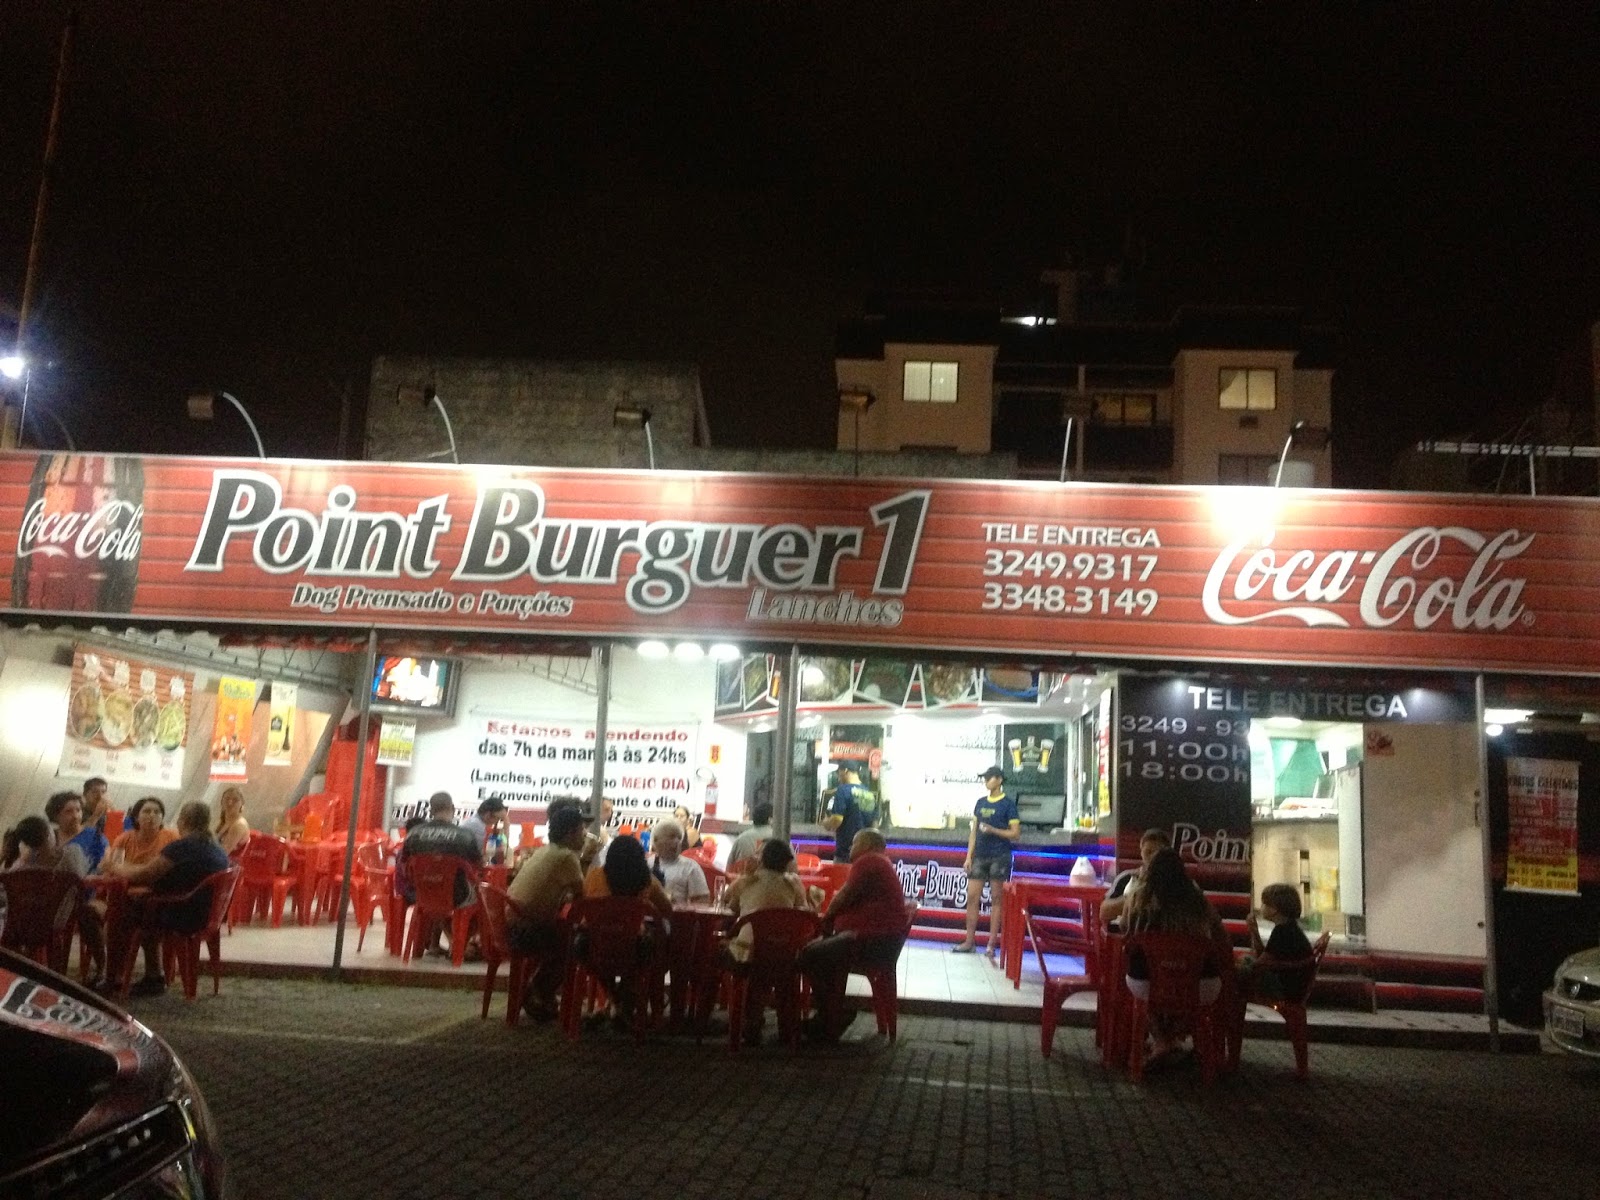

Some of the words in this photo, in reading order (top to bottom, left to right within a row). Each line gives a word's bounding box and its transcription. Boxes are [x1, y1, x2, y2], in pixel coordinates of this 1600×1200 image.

[17, 497, 144, 561] Coca-Cola
[184, 468, 453, 578] Point
[450, 477, 864, 615] Burguer
[869, 488, 933, 597] 1
[981, 522, 1038, 545] TELE
[1043, 525, 1162, 548] ENTREGA
[983, 549, 1159, 582] 3249.9317
[1201, 526, 1537, 631] Coca-Cola
[291, 582, 342, 614] Dog
[343, 585, 455, 613] Prensado
[456, 592, 475, 614] e
[476, 589, 574, 621] Porções
[745, 588, 905, 627] Lanches
[981, 582, 1159, 616] 3348.3149
[1187, 686, 1260, 711] TELE
[1270, 691, 1408, 718] ENTREGA
[584, 728, 689, 741] aendendo
[1121, 715, 1188, 735] 3249
[478, 738, 507, 757] das
[513, 740, 532, 758] 7h
[537, 743, 557, 759] da
[562, 744, 618, 762] manã
[623, 745, 643, 763] às
[648, 746, 687, 765] 24hs
[621, 776, 657, 790] MEIO
[661, 778, 691, 793] DIA)
[643, 799, 651, 808] o
[656, 796, 677, 808] dia
[1170, 821, 1252, 863] Poin
